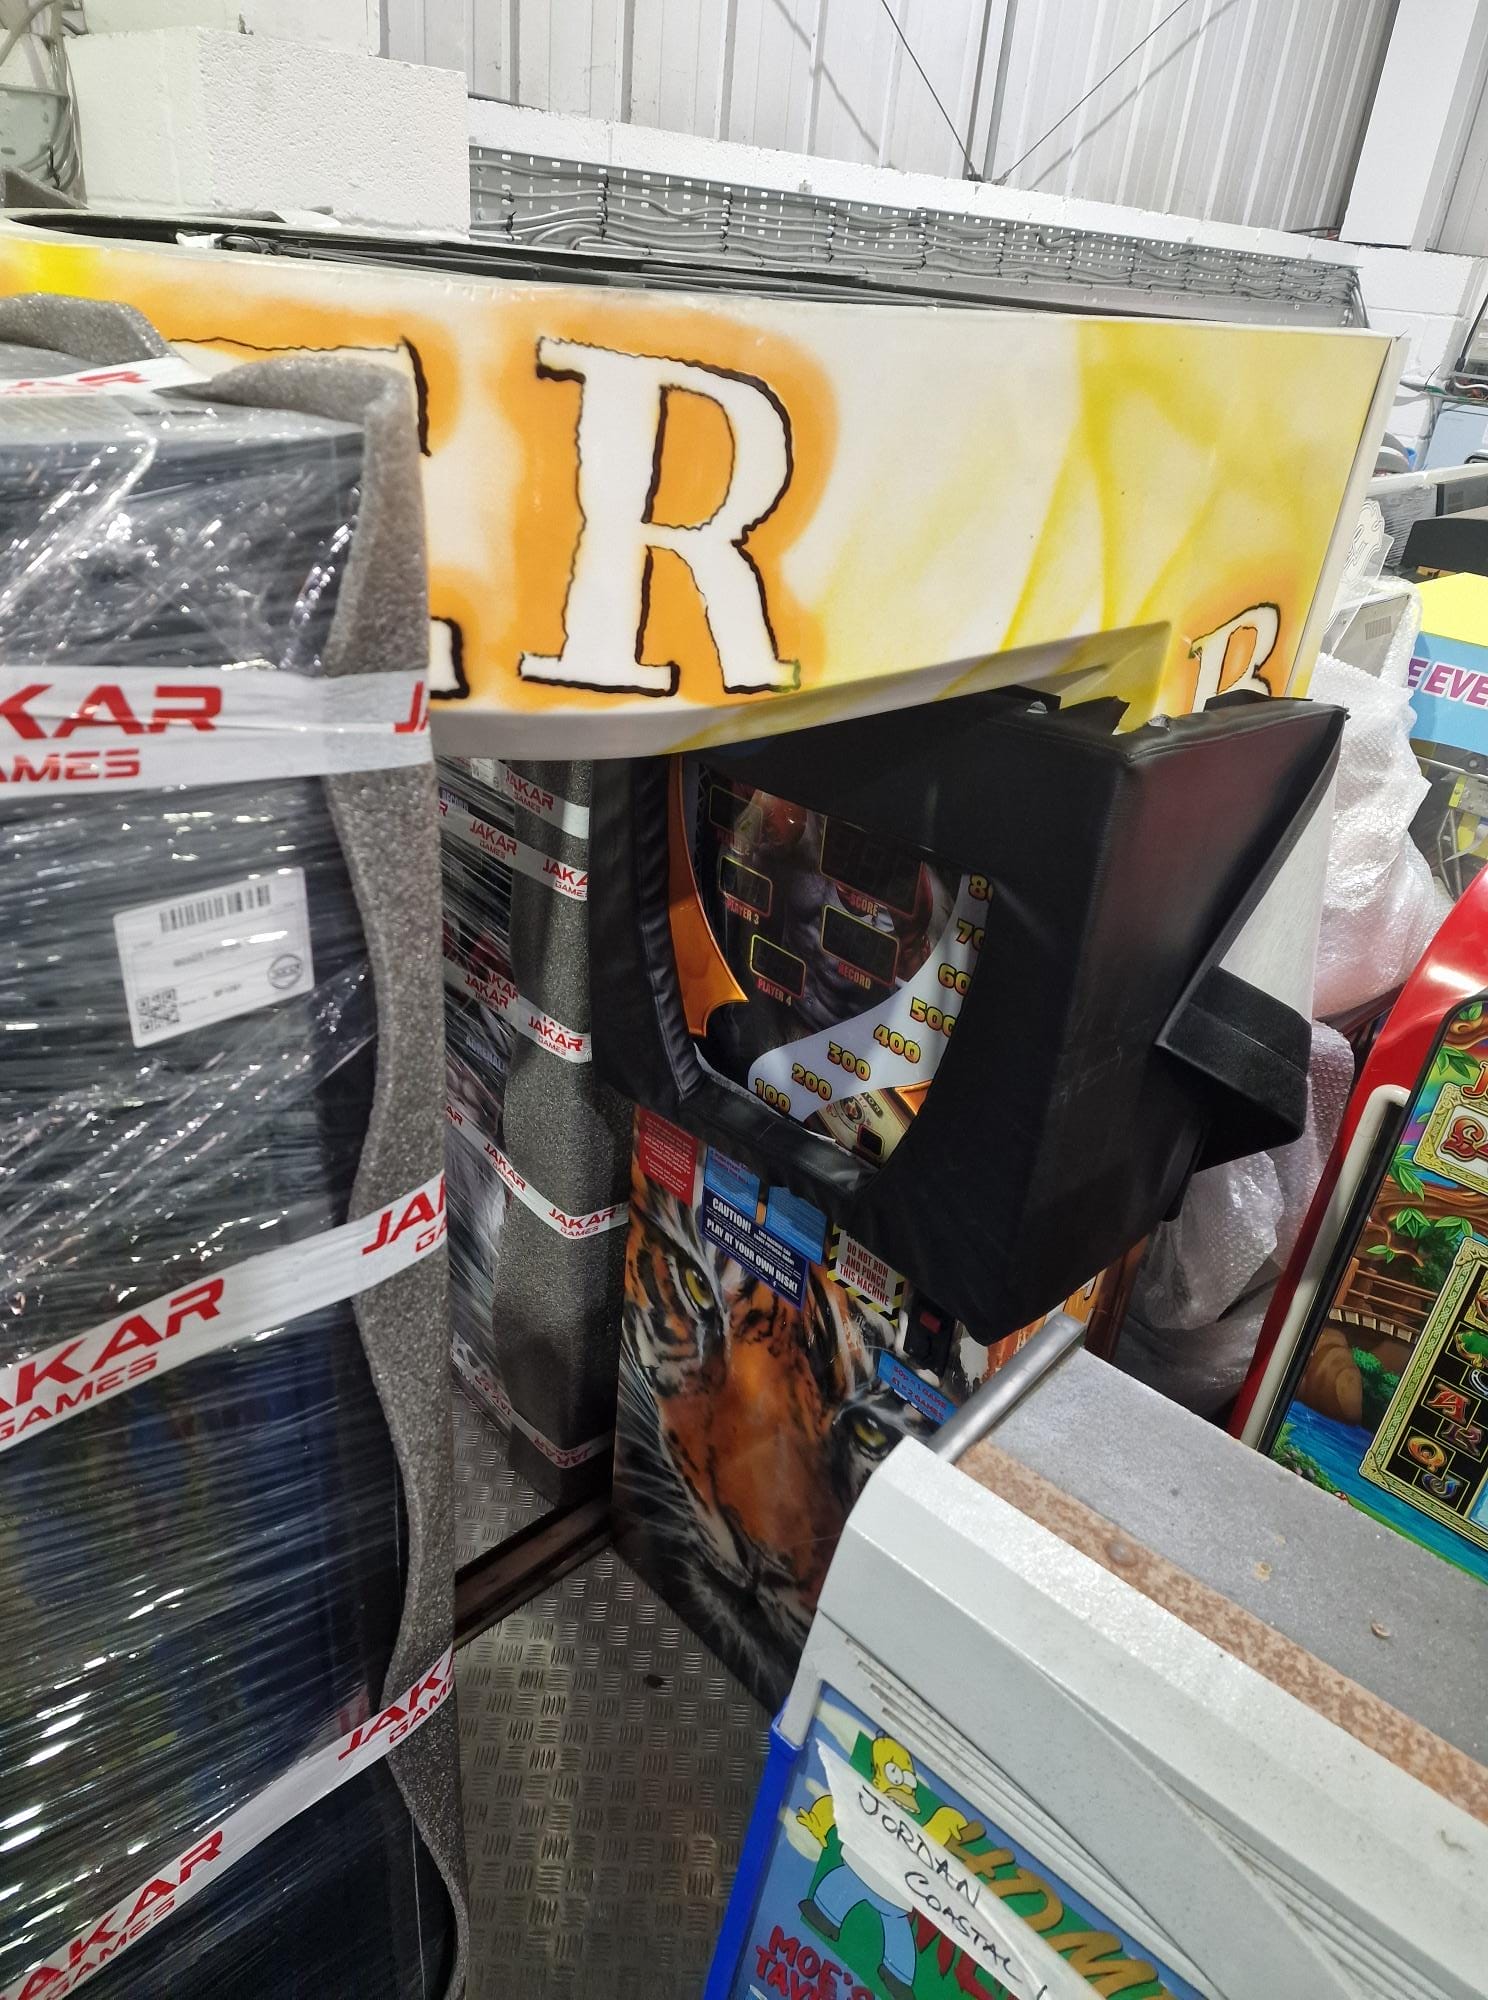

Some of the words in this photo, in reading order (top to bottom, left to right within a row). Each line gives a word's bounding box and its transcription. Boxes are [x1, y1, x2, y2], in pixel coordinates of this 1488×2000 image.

[1423, 664, 1488, 707] EVE
[0, 748, 139, 783] MES
[505, 768, 554, 811] JAKAR
[470, 819, 517, 856] JAKAR
[543, 858, 589, 887] JAKA
[726, 898, 752, 921] PLAYER
[753, 913, 760, 925] 3
[850, 892, 879, 917] SCORE
[756, 978, 784, 1002] PLAYER
[785, 996, 792, 1007] 4
[837, 962, 872, 990] RECORD
[465, 973, 509, 1010] JAKAR
[528, 1015, 583, 1052] JAKAR
[538, 1035, 567, 1057] GAMES
[827, 1040, 871, 1082] 300
[873, 1023, 922, 1064] 400
[754, 1077, 792, 1114] 100
[791, 1062, 833, 1101] 200
[484, 1142, 527, 1192] JAKAR
[548, 1206, 617, 1230] JAKAR
[560, 1226, 599, 1237] GAMES
[712, 1197, 752, 1234] CAUTION!
[706, 1218, 724, 1238] PLAY
[724, 1230, 734, 1246] AT
[734, 1237, 755, 1262] YOUR
[755, 1254, 775, 1277] OWN
[775, 1269, 798, 1294] RISK!
[845, 1254, 860, 1273] AND
[861, 1264, 886, 1292] PUNCH
[847, 1241, 857, 1257] DO
[858, 1247, 873, 1267] NOT
[873, 1260, 889, 1279] RUN
[840, 1263, 855, 1281] THIS
[856, 1277, 890, 1307] MACHINE
[338, 1650, 455, 1761] JAK
[856, 1785, 982, 1908] JORDAN
[0, 1831, 223, 2000] AKAR
[904, 1871, 1023, 1984] COASTAL
